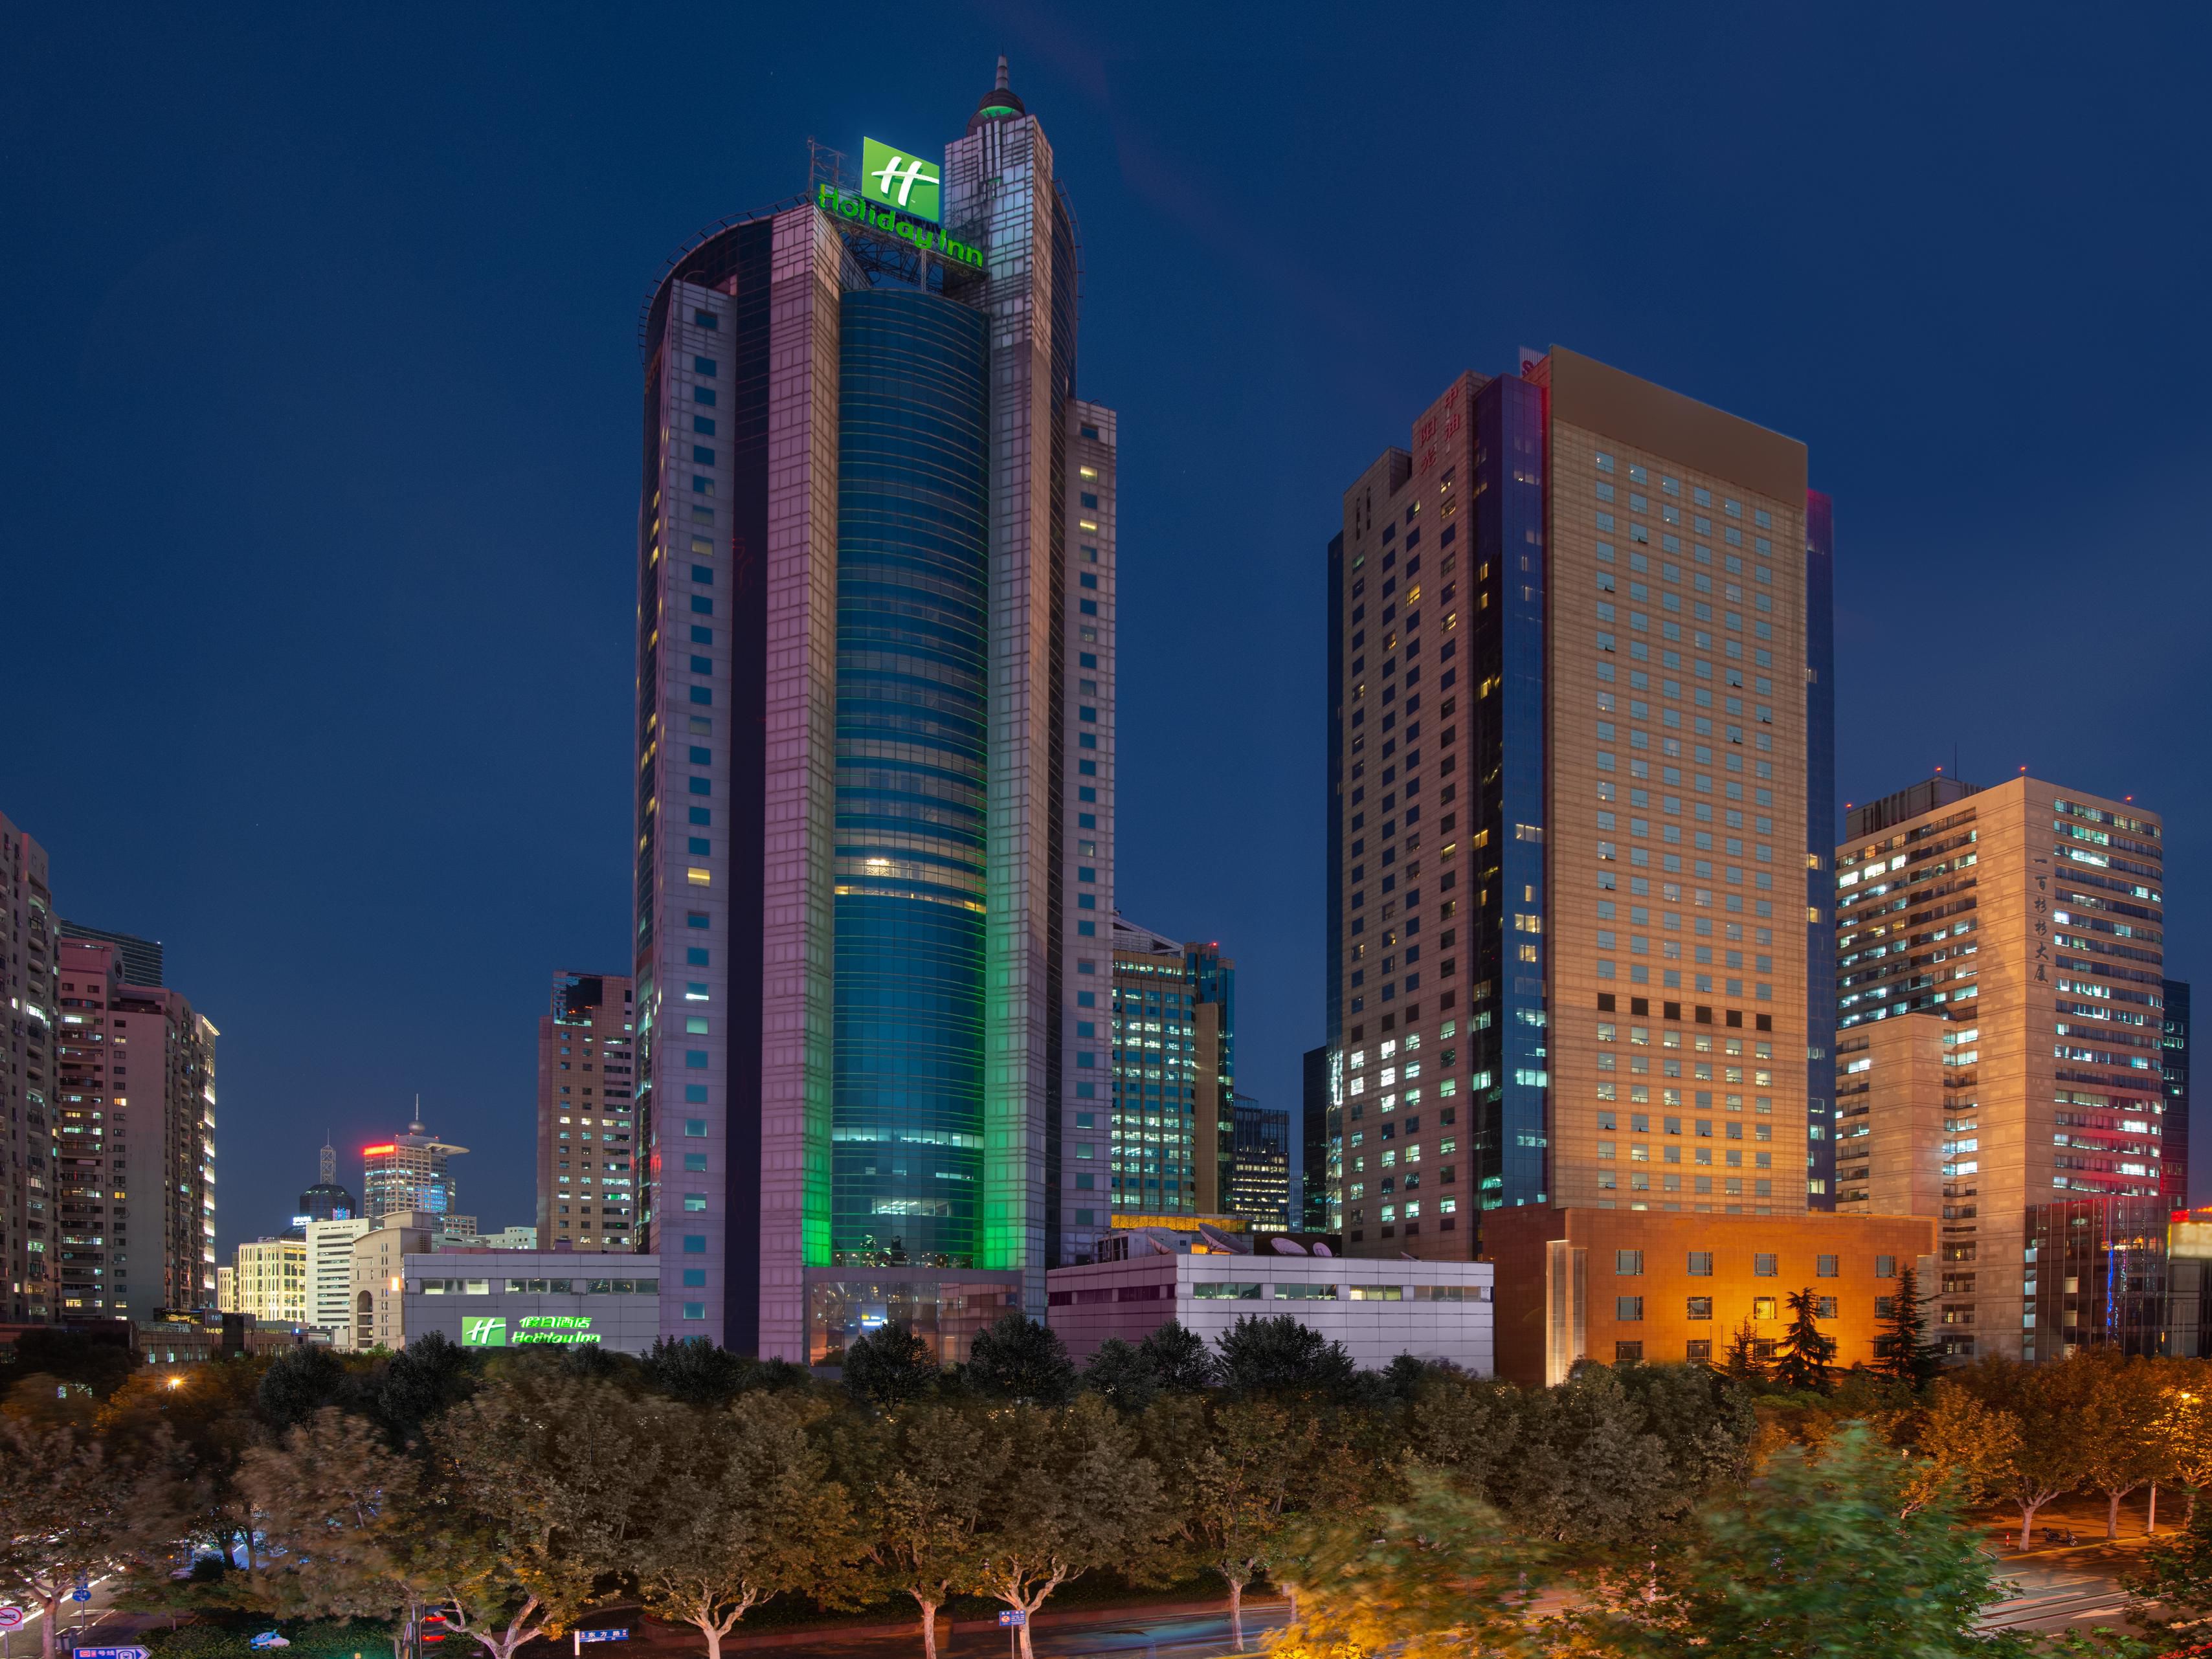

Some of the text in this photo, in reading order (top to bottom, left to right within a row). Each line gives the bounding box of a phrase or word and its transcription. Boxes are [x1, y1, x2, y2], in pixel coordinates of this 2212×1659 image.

[818, 183, 984, 268] Holiday Inn
[1420, 416, 1437, 475] 阳光
[2033, 858, 2049, 983] 一百杉杉大厦
[519, 1316, 592, 1329] 假日酒店
[575, 1331, 601, 1344] Inn
